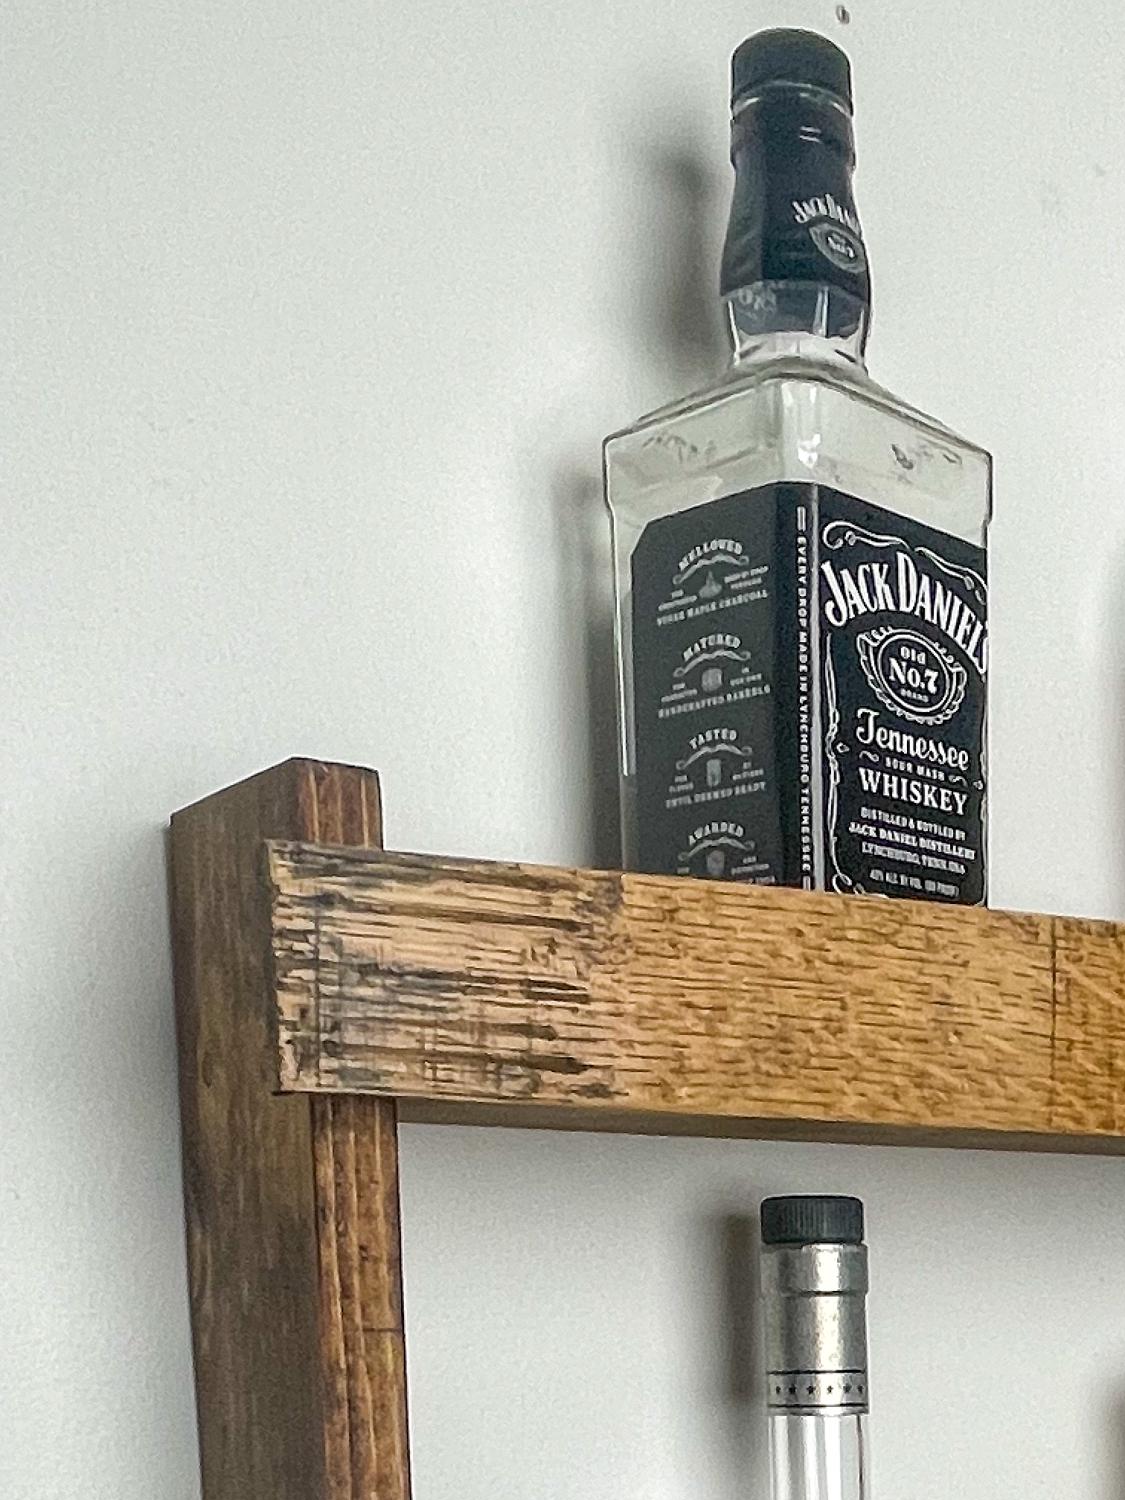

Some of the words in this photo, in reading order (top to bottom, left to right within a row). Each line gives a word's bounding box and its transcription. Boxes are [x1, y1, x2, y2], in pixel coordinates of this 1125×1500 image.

[679, 539, 743, 571] MELLOWED
[797, 536, 807, 584] EVERY
[798, 588, 807, 627] DROP
[821, 560, 896, 627] JACK
[683, 634, 741, 661] MATURED
[799, 631, 808, 672] MADE
[900, 646, 927, 666] Old
[800, 676, 808, 692] IN
[888, 656, 939, 694] No.7
[689, 728, 738, 750] TASTED
[855, 708, 969, 771] Tennessee
[858, 767, 968, 815] WHISKEY
[689, 822, 744, 846] AWARDED
[801, 787, 812, 872] TENNESSEE
[849, 821, 877, 838] JACK
[878, 827, 918, 847] DANIEL
